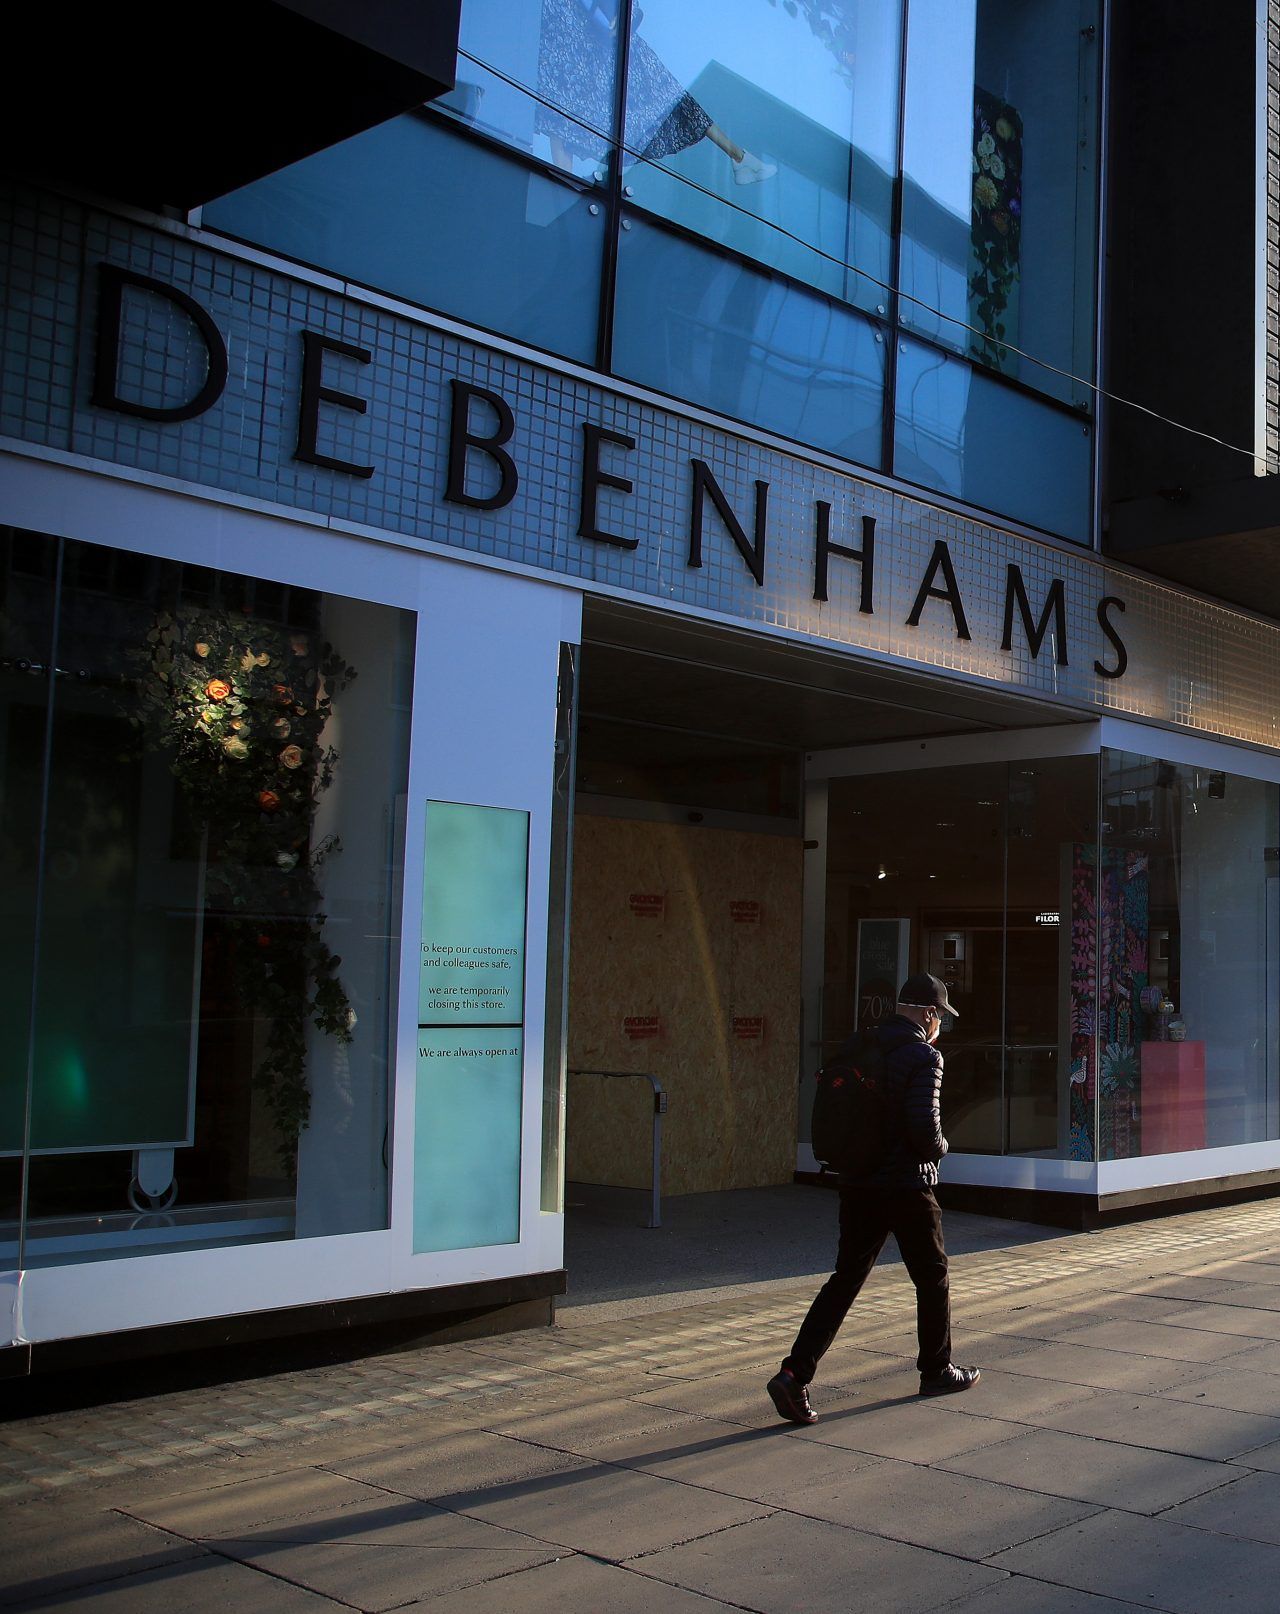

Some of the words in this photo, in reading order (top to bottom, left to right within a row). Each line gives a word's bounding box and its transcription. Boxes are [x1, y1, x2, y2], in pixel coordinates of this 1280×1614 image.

[92, 262, 1128, 679] DEBENHAMS
[432, 942, 454, 955] keep
[456, 945, 471, 954] our
[473, 946, 518, 955] customers
[423, 957, 441, 967] and
[443, 958, 489, 970] colleagues
[491, 959, 511, 969] safe,
[428, 987, 441, 995] we
[443, 987, 458, 995] are
[460, 985, 510, 997] temporarily
[428, 999, 460, 1011] closing
[462, 999, 479, 1009] this
[481, 1000, 506, 1009] store.
[419, 1047, 435, 1057] We
[437, 1049, 451, 1057] are
[453, 1047, 483, 1058] always
[485, 1048, 507, 1058] open
[509, 1048, 518, 1056] at
